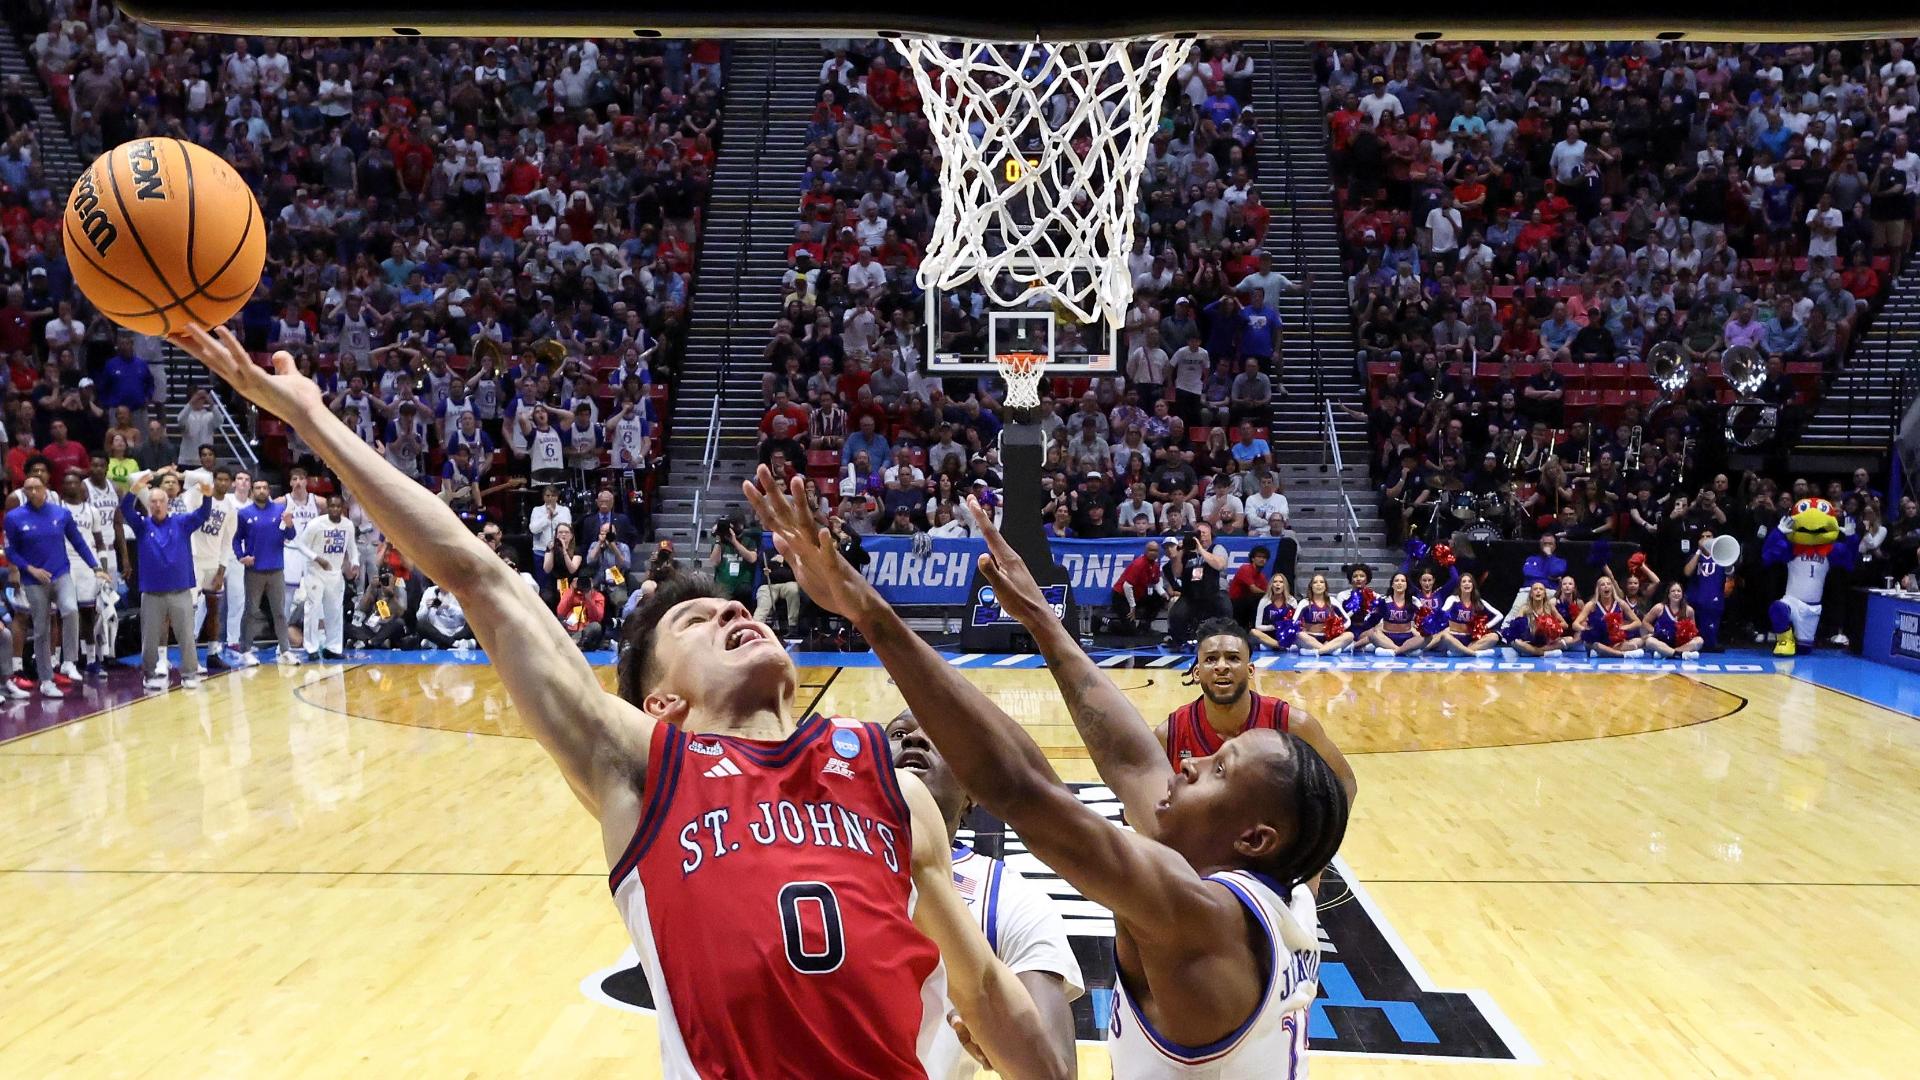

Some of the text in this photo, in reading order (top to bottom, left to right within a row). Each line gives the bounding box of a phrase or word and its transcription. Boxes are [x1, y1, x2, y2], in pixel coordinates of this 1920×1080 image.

[545, 443, 554, 458] 6
[823, 763, 856, 777] EAST
[829, 757, 850, 769] BIG
[679, 801, 899, 878] ST. JOHN'S
[777, 881, 845, 975] 0
